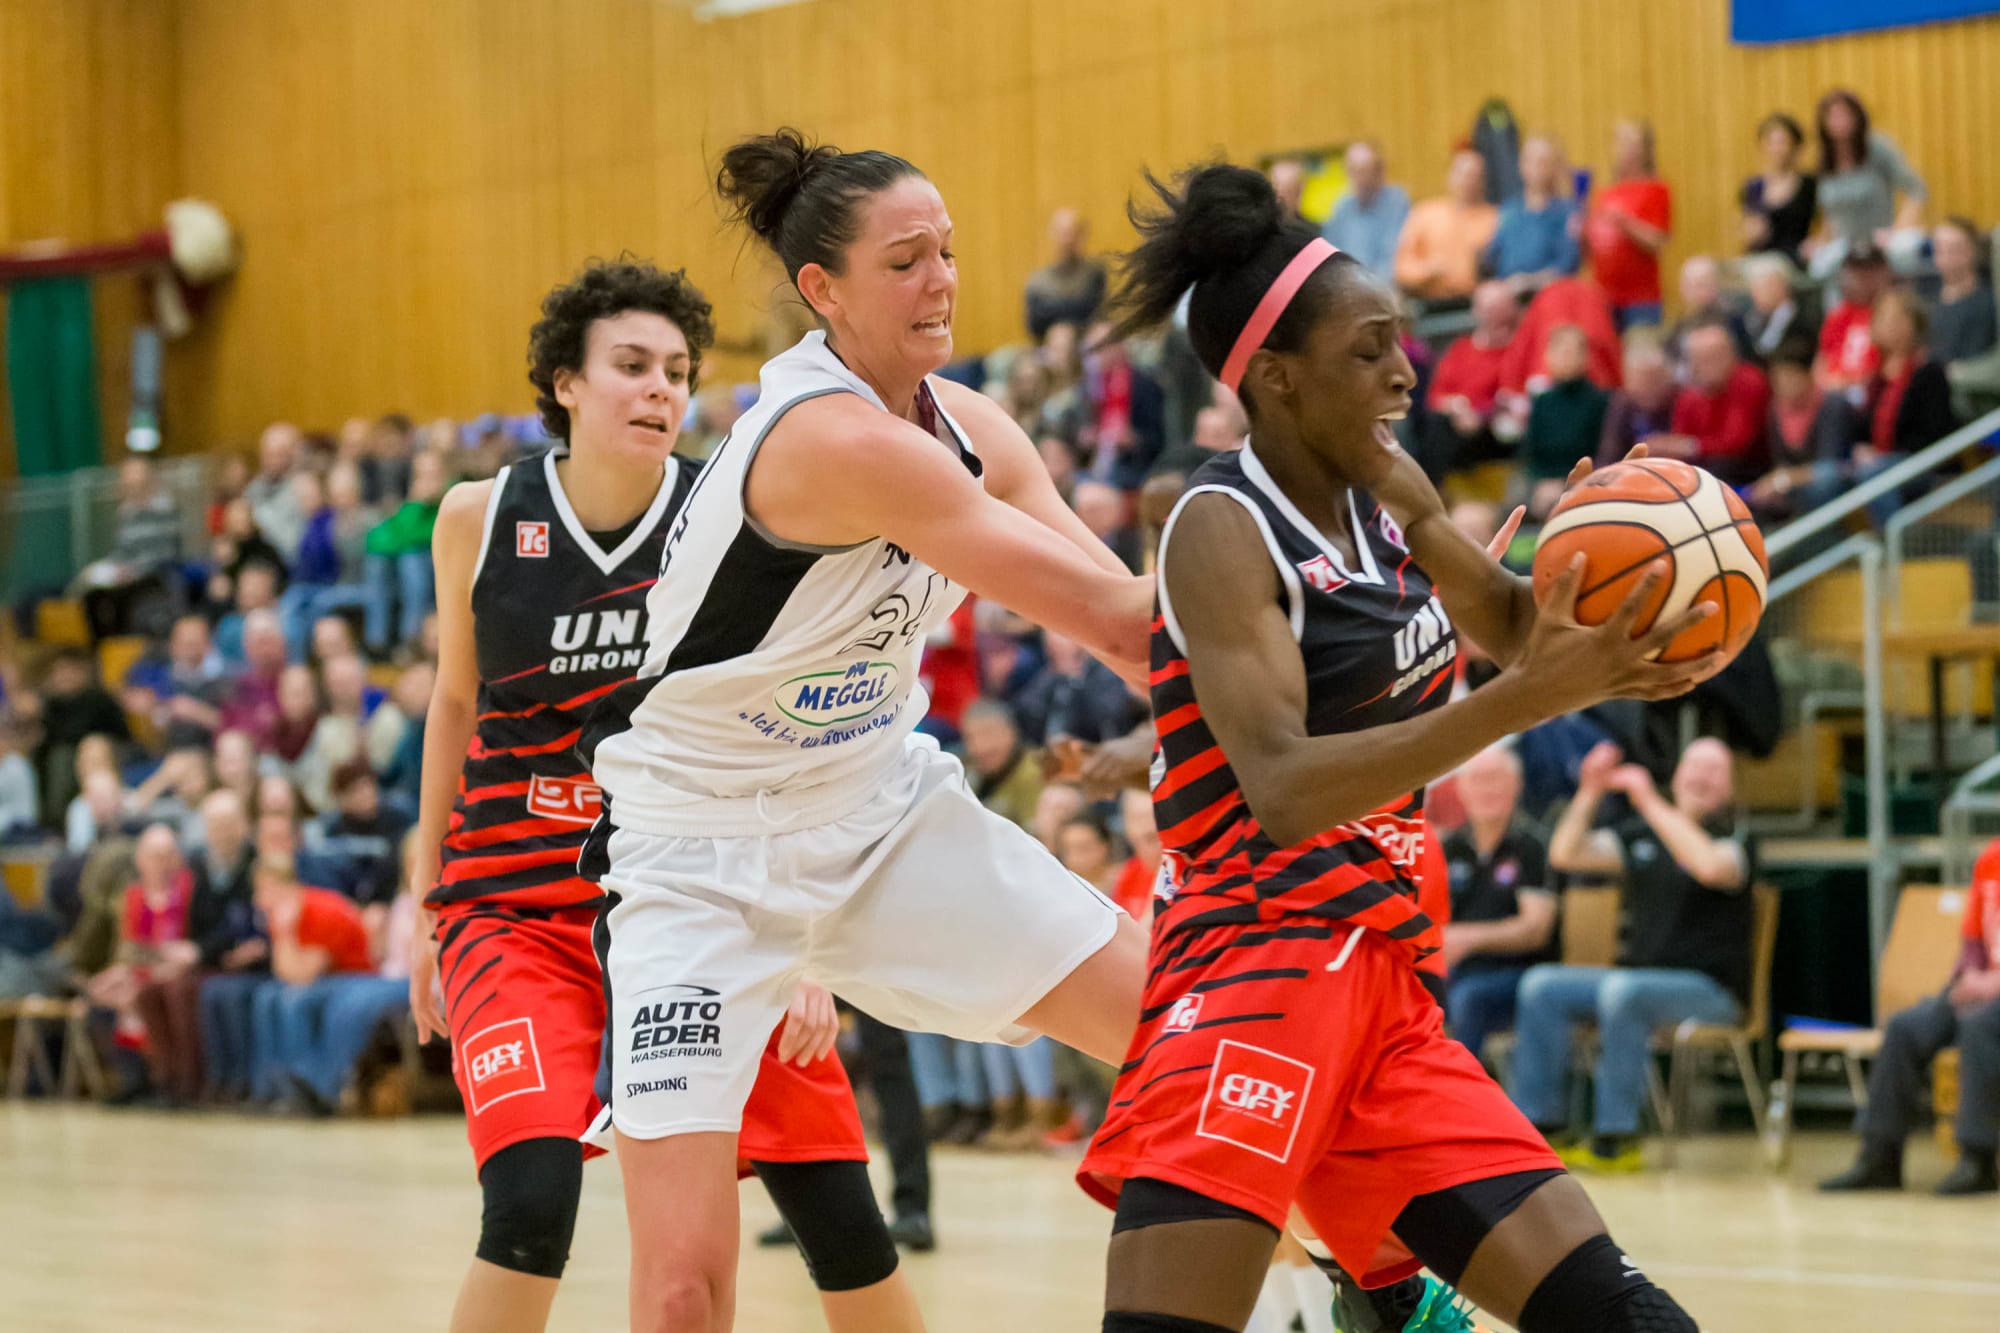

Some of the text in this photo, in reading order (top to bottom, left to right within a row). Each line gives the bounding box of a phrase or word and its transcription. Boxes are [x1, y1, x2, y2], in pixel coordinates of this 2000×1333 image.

[548, 648, 646, 676] GIRON
[794, 671, 888, 711] MEGGLE
[630, 1001, 722, 1030] AUTO
[631, 1023, 721, 1052] EDER
[631, 1046, 722, 1065] WASSERBURG
[626, 1075, 688, 1099] SPALDING
